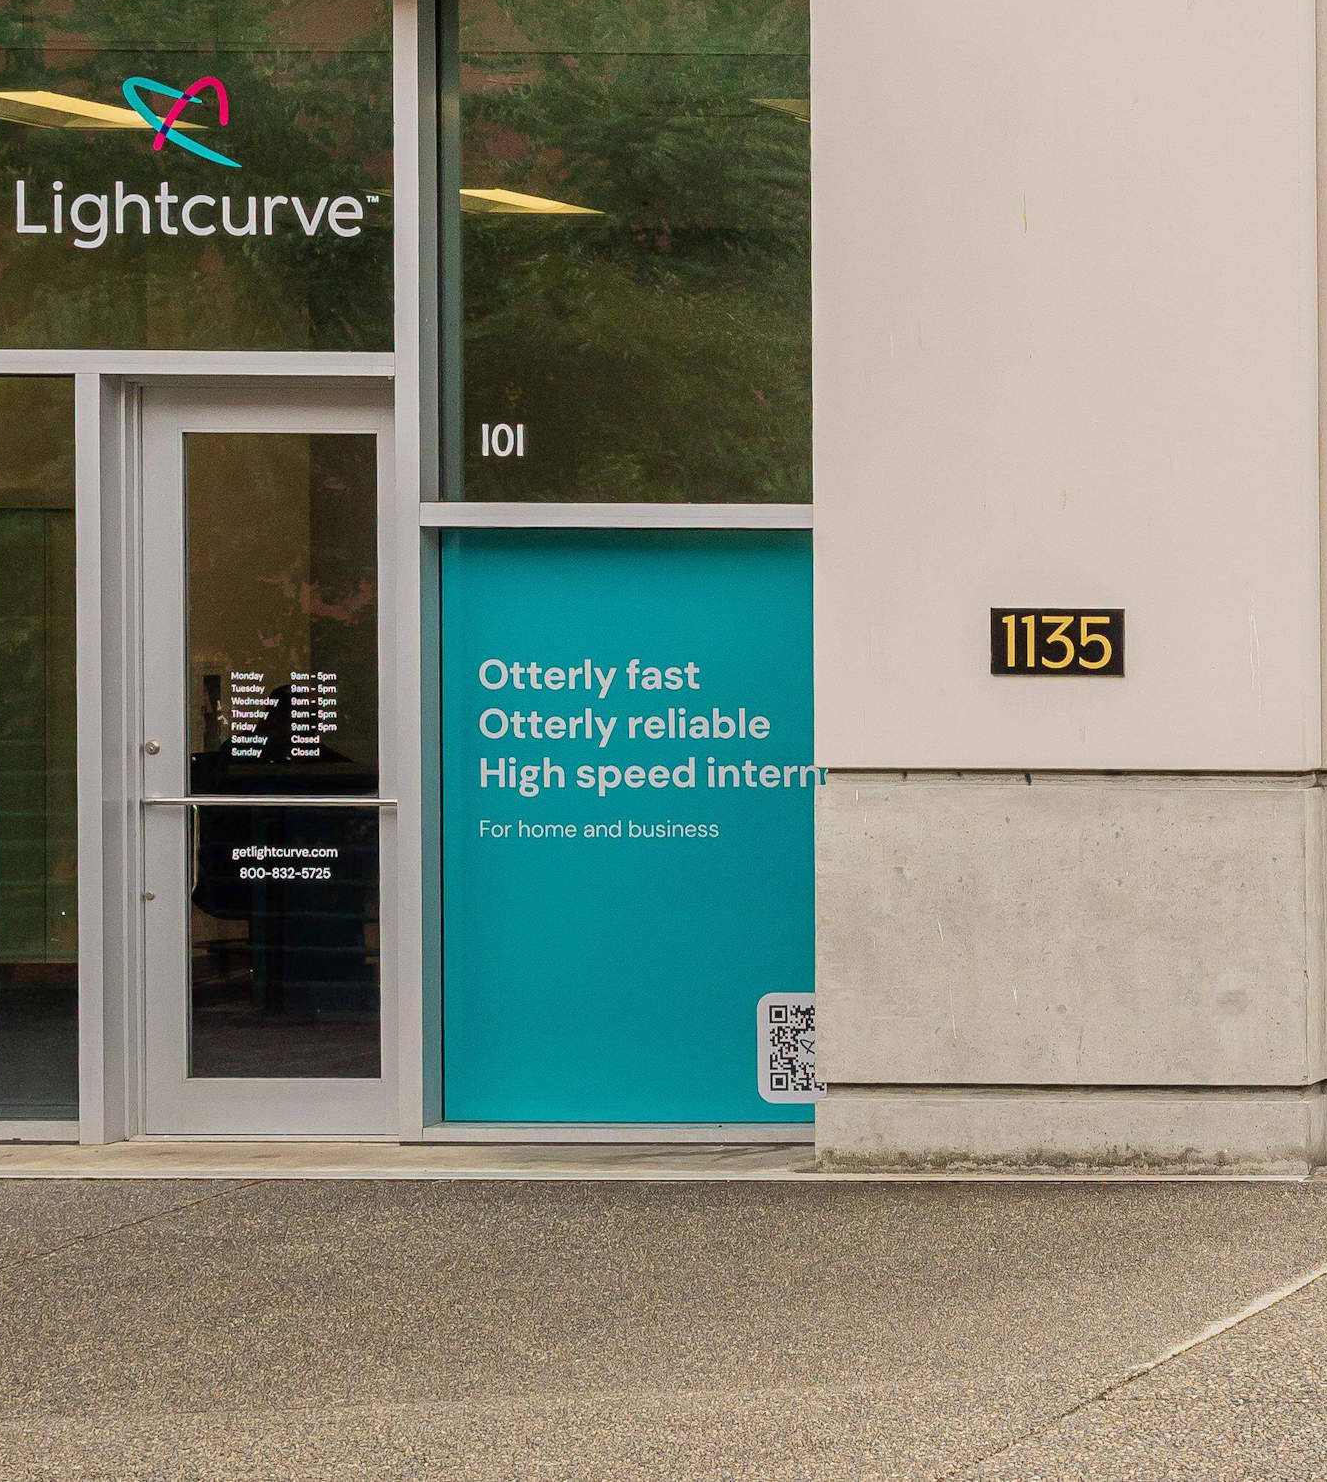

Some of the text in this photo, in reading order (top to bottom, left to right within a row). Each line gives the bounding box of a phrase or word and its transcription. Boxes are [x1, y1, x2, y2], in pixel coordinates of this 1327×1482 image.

[481, 423, 524, 457] 101
[1001, 614, 1113, 670] 1135
[231, 672, 264, 682] Monday
[317, 672, 337, 682] 5pm
[478, 658, 700, 699] Otterly fast
[231, 684, 265, 694] Tuesday
[317, 684, 337, 694] 5pm
[231, 697, 279, 707] Wednesday
[317, 697, 337, 707] 5pm
[231, 710, 269, 720] Thursday
[317, 710, 337, 720] 5pm
[231, 722, 257, 732] Friday
[317, 722, 337, 732] 5pm
[479, 707, 771, 748] Otterly reliable
[231, 735, 320, 745] Saturday Closed
[231, 748, 320, 758] Sunday Closed
[480, 756, 827, 798] High speed intern
[479, 819, 719, 838] For home and business
[231, 845, 339, 861] getlightcurve.com
[239, 867, 332, 880] 800-832-5725
